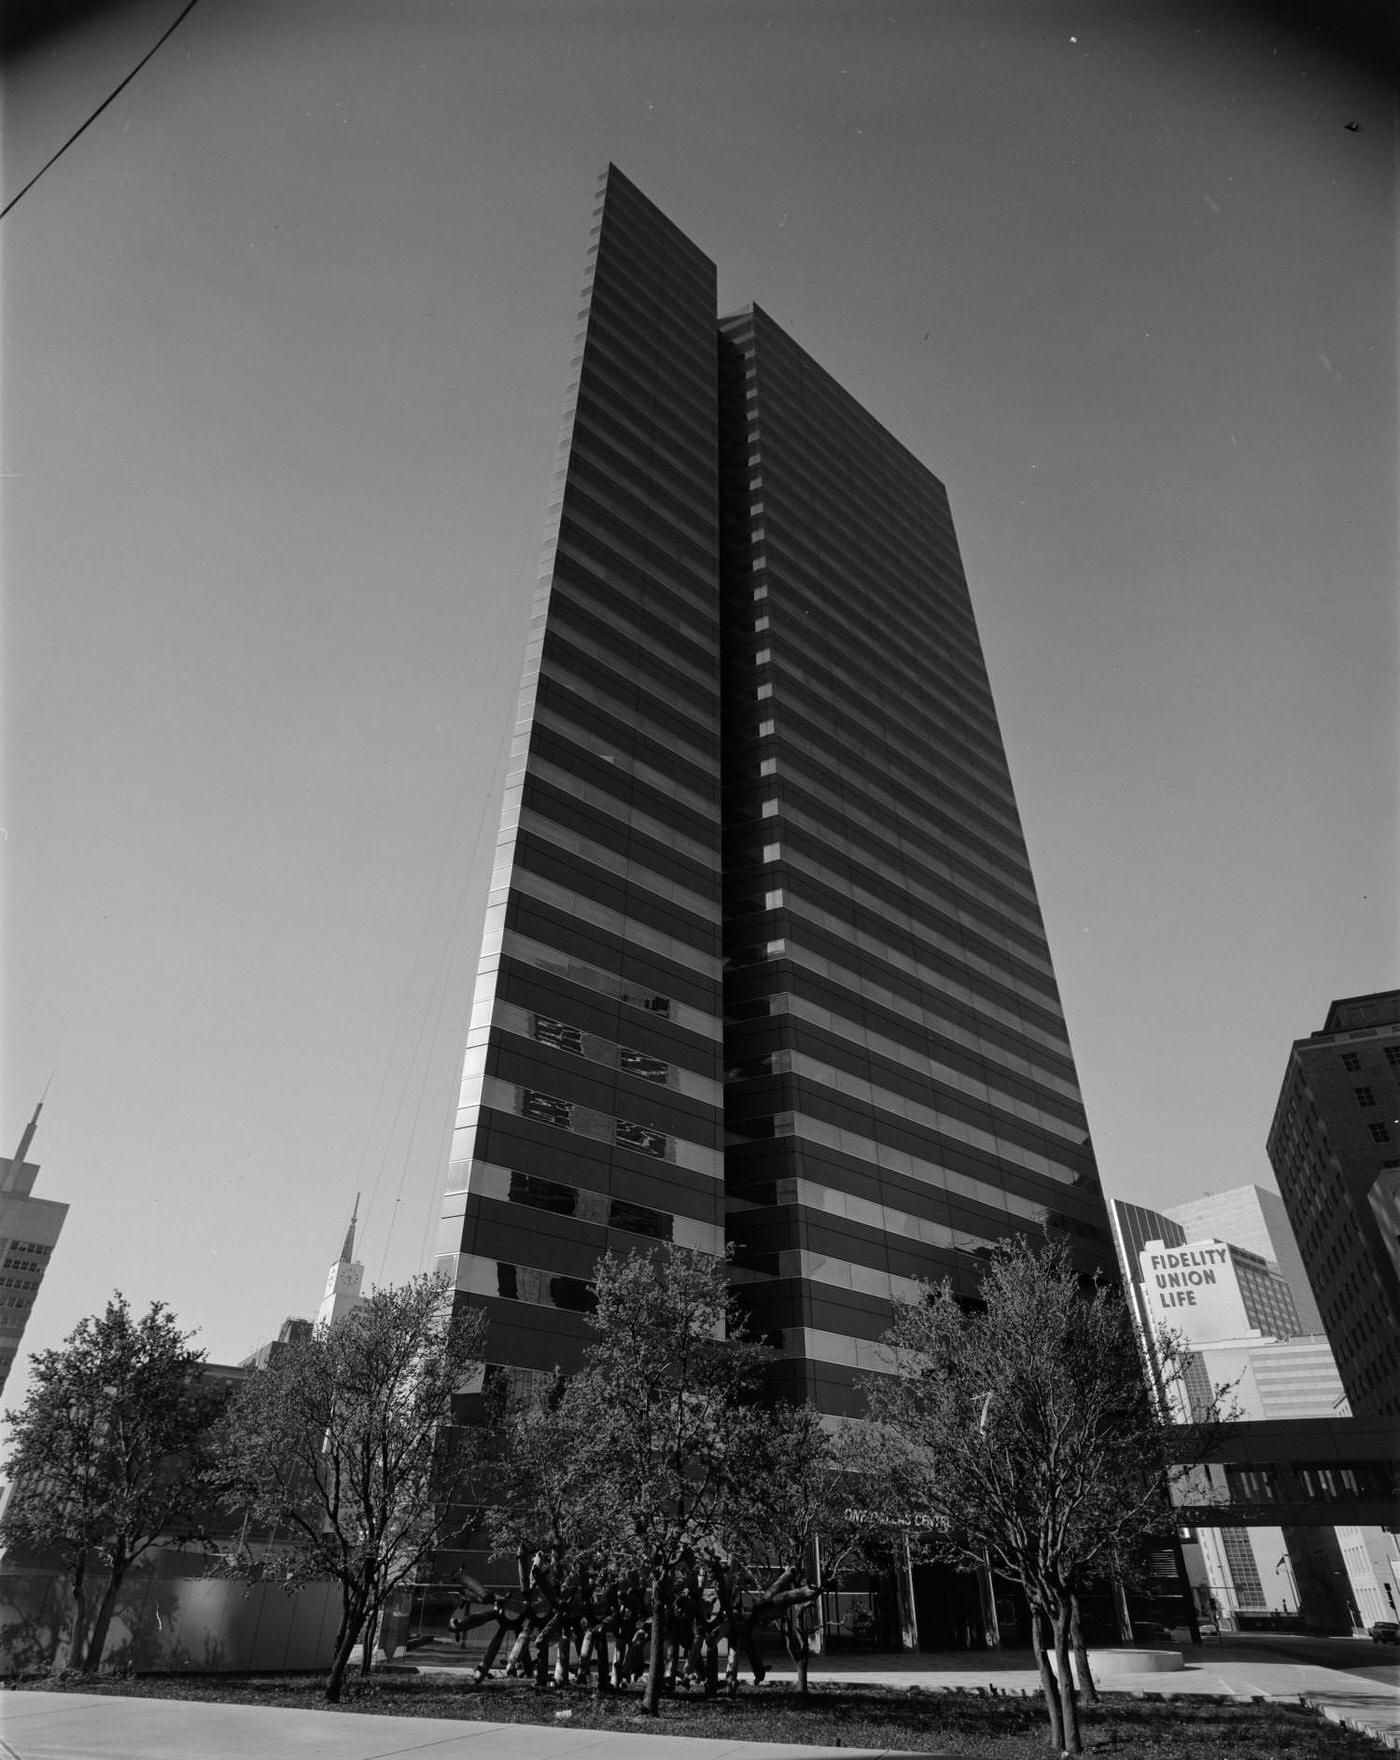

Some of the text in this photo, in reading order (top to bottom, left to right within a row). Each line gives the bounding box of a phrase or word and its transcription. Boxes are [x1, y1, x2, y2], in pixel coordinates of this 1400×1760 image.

[1151, 1249, 1226, 1270] FIDELITY
[1155, 1269, 1216, 1288] UNION
[1160, 1290, 1197, 1308] LIFE
